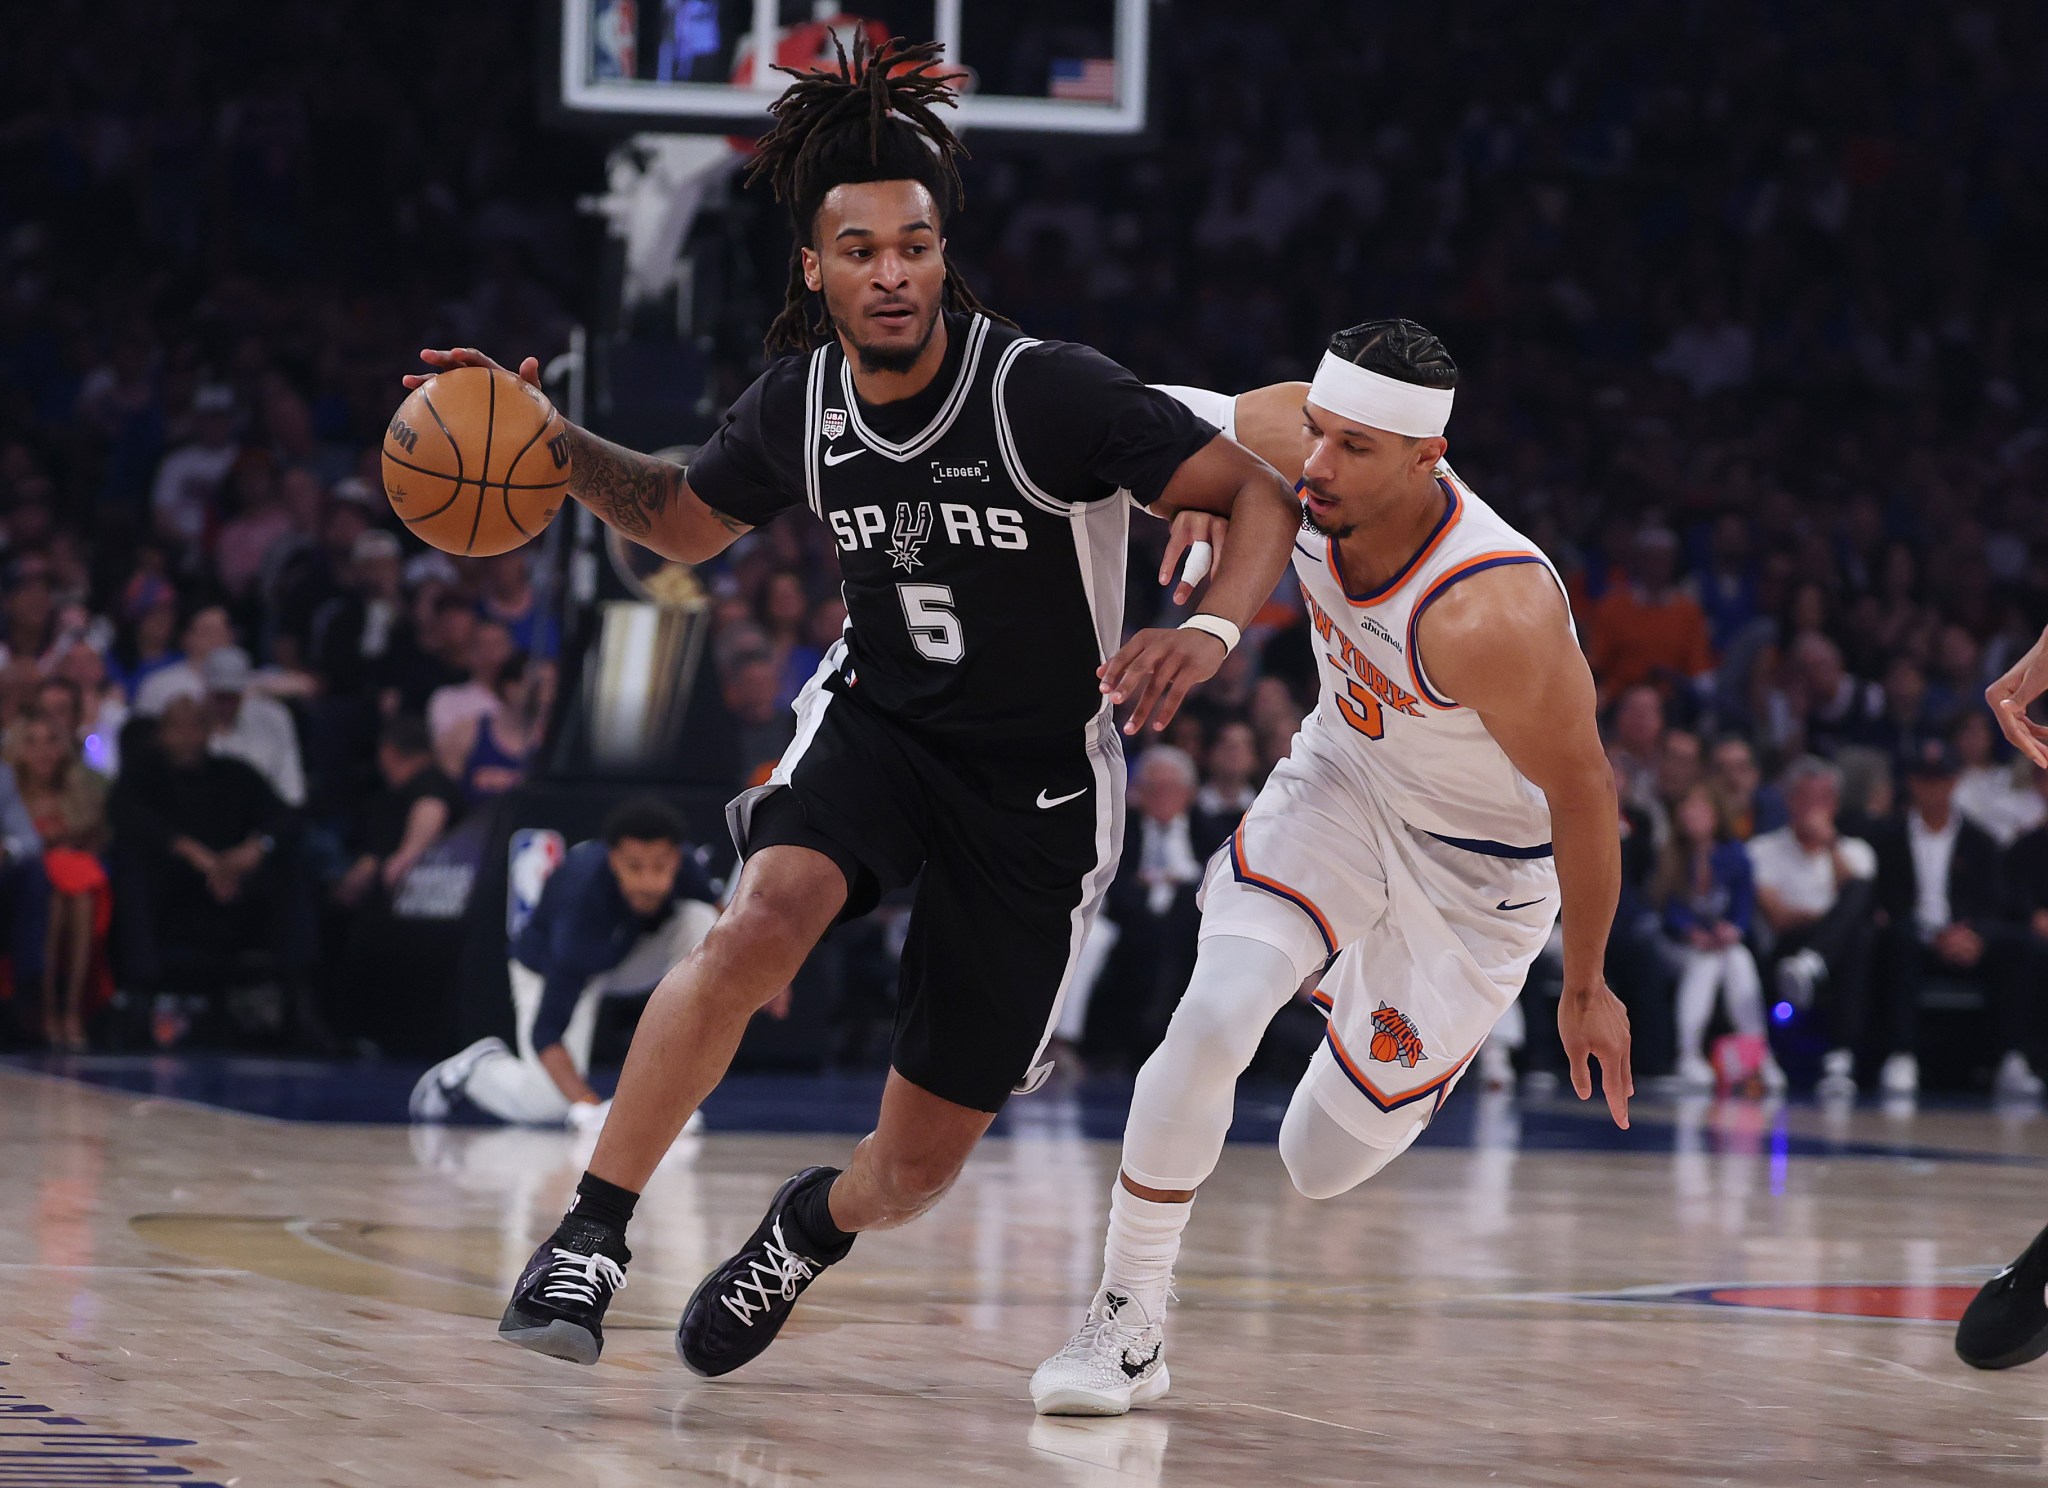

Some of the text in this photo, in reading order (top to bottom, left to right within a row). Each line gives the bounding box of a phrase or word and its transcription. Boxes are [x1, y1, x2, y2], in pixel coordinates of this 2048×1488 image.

[824, 424, 842, 433] 250
[826, 412, 844, 421] USA
[938, 467, 982, 478] LEDGER
[829, 502, 1029, 553] SPURS
[895, 582, 966, 665] 5
[1360, 621, 1380, 637] abu
[1334, 626, 1428, 719] YORK
[1399, 1013, 1420, 1037] NEW YORK
[1371, 1007, 1424, 1069] KNICKS
